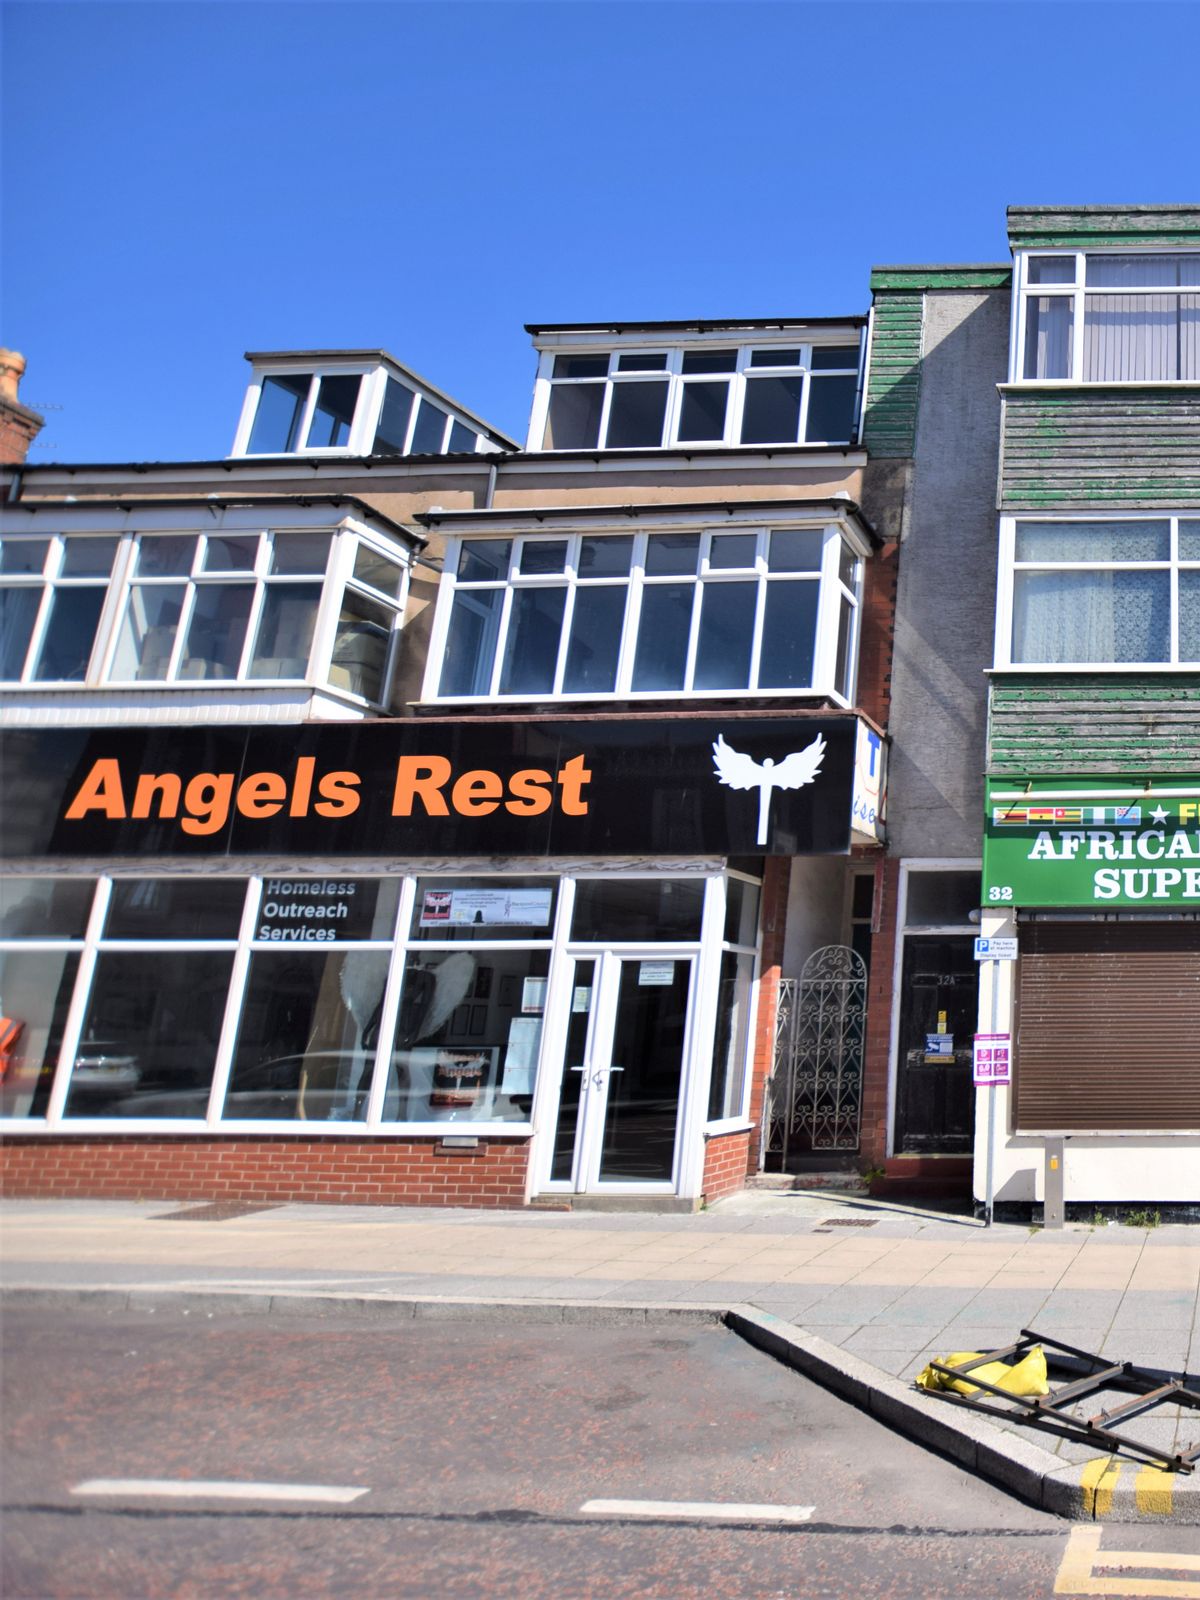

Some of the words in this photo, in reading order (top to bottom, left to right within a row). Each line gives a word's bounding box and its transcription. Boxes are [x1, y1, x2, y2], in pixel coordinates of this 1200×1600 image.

[64, 757, 361, 835] Angels
[391, 754, 592, 817] Rest
[267, 880, 356, 895] Homeless
[989, 887, 1013, 901] 32
[263, 902, 348, 918] Outreach
[259, 925, 336, 941] Services
[979, 941, 987, 951] P
[936, 975, 955, 985] 32A
